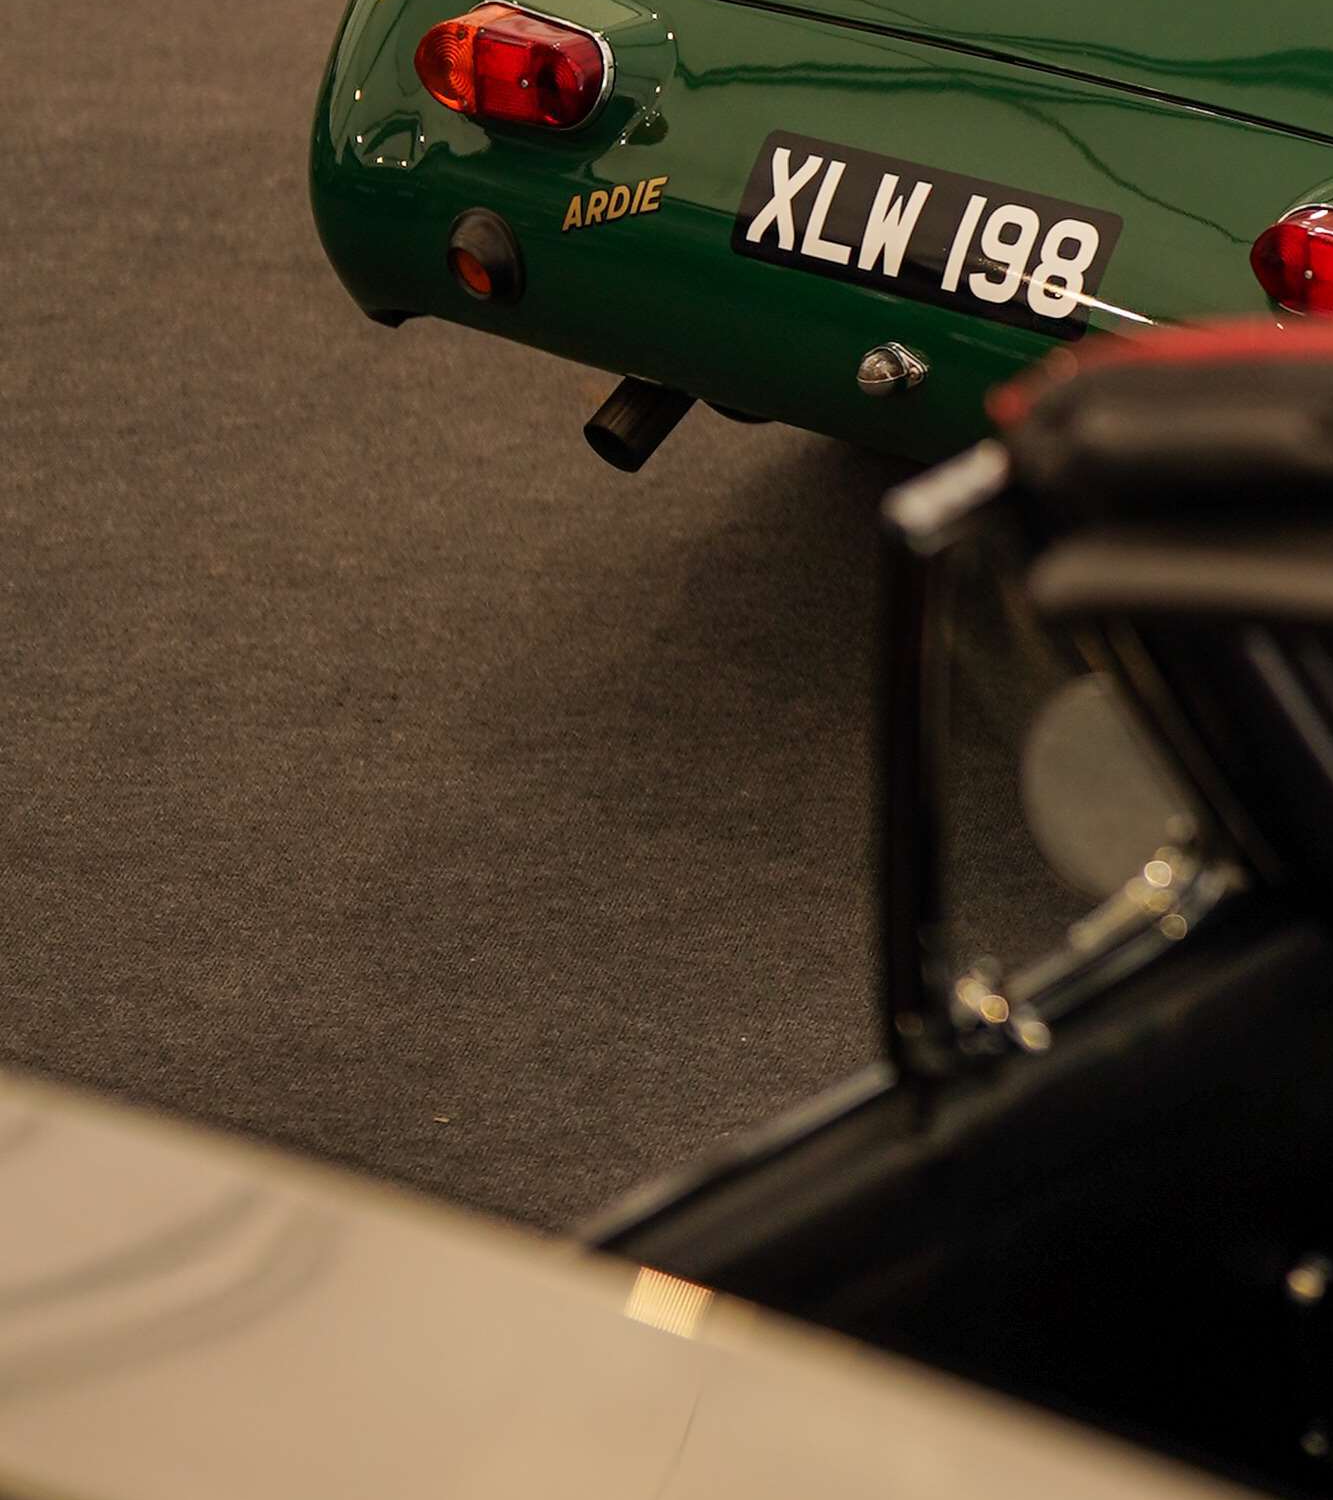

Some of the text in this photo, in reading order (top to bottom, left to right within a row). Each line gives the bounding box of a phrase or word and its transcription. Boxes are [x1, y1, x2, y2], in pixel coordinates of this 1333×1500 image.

[561, 175, 669, 233] ARDIE
[745, 146, 1100, 319] XLW 198
